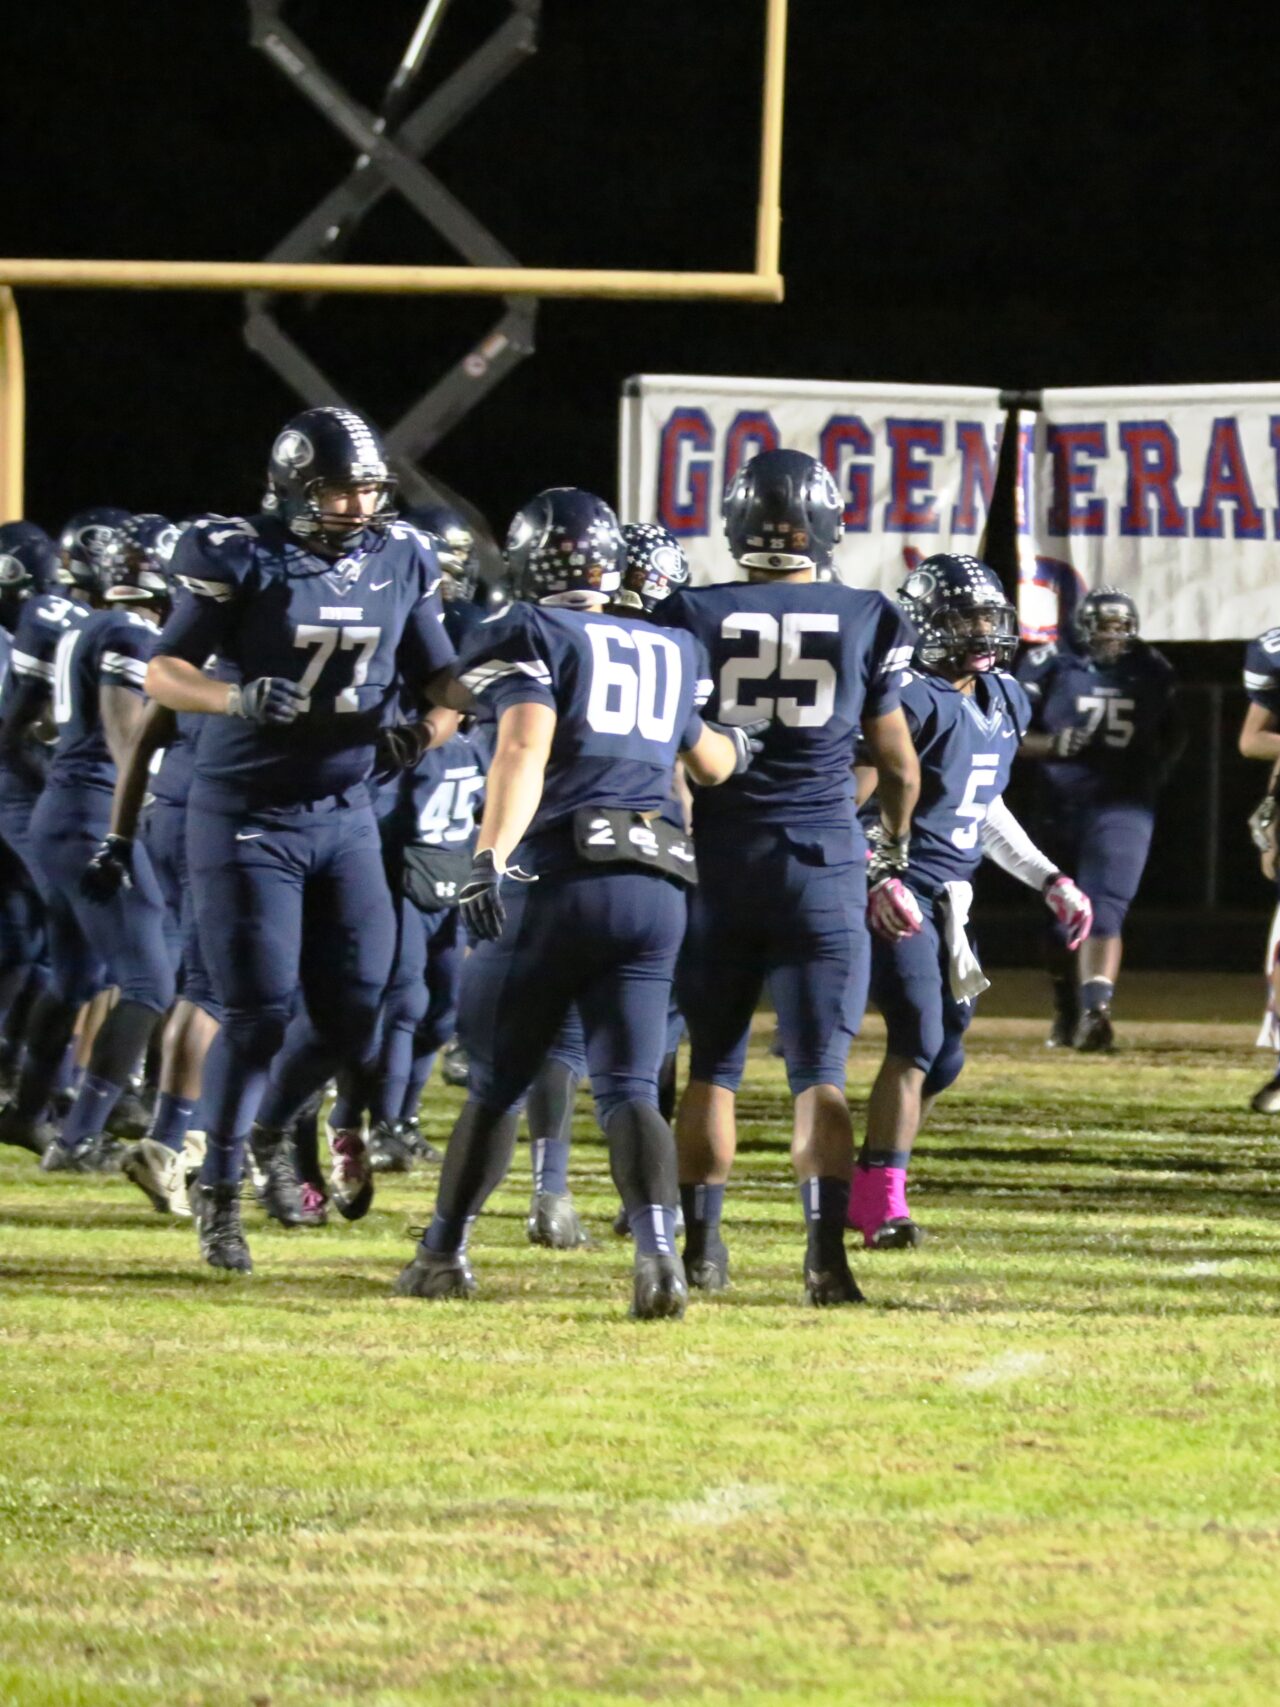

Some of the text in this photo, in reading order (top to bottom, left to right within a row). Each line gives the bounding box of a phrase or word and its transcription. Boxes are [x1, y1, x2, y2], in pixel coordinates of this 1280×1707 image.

[294, 624, 381, 713] 77
[585, 623, 681, 743] 60
[718, 612, 839, 727] 25
[1076, 696, 1136, 748] 75
[419, 776, 486, 844] 45
[951, 769, 998, 849] 5
